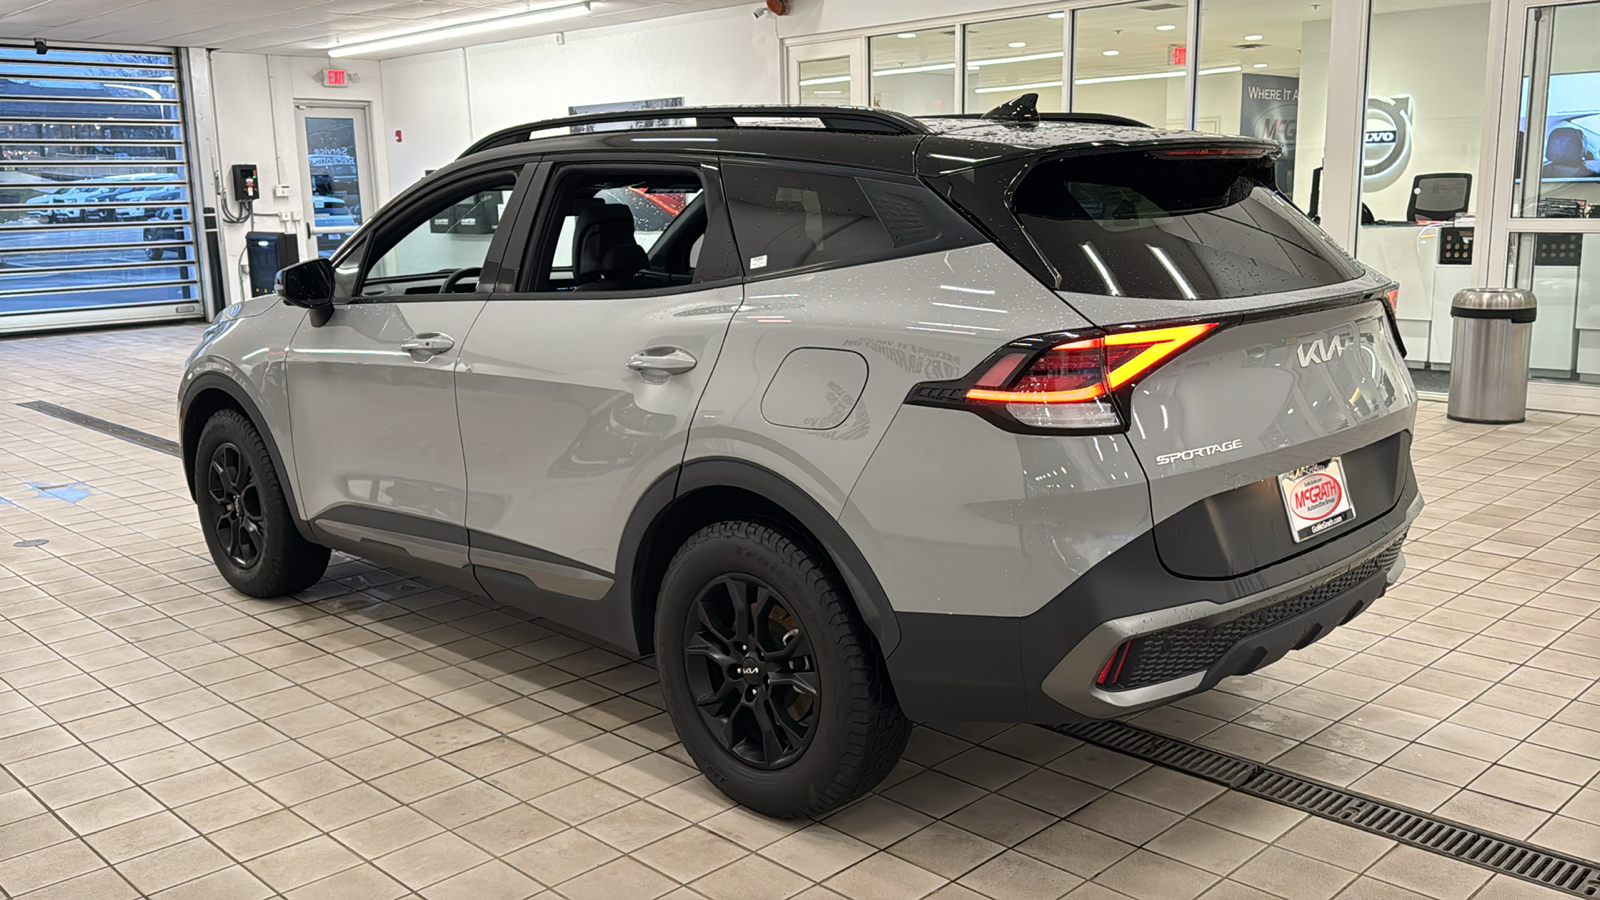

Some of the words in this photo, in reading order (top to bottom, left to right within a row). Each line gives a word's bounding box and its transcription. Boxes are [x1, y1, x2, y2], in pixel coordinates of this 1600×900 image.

[327, 69, 345, 85] EXIT
[1248, 86, 1282, 100] WHERE
[1283, 88, 1291, 100] IT
[1365, 132, 1394, 142] LVO
[1297, 335, 1344, 368] KIA
[1156, 439, 1243, 465] SPORTAGE
